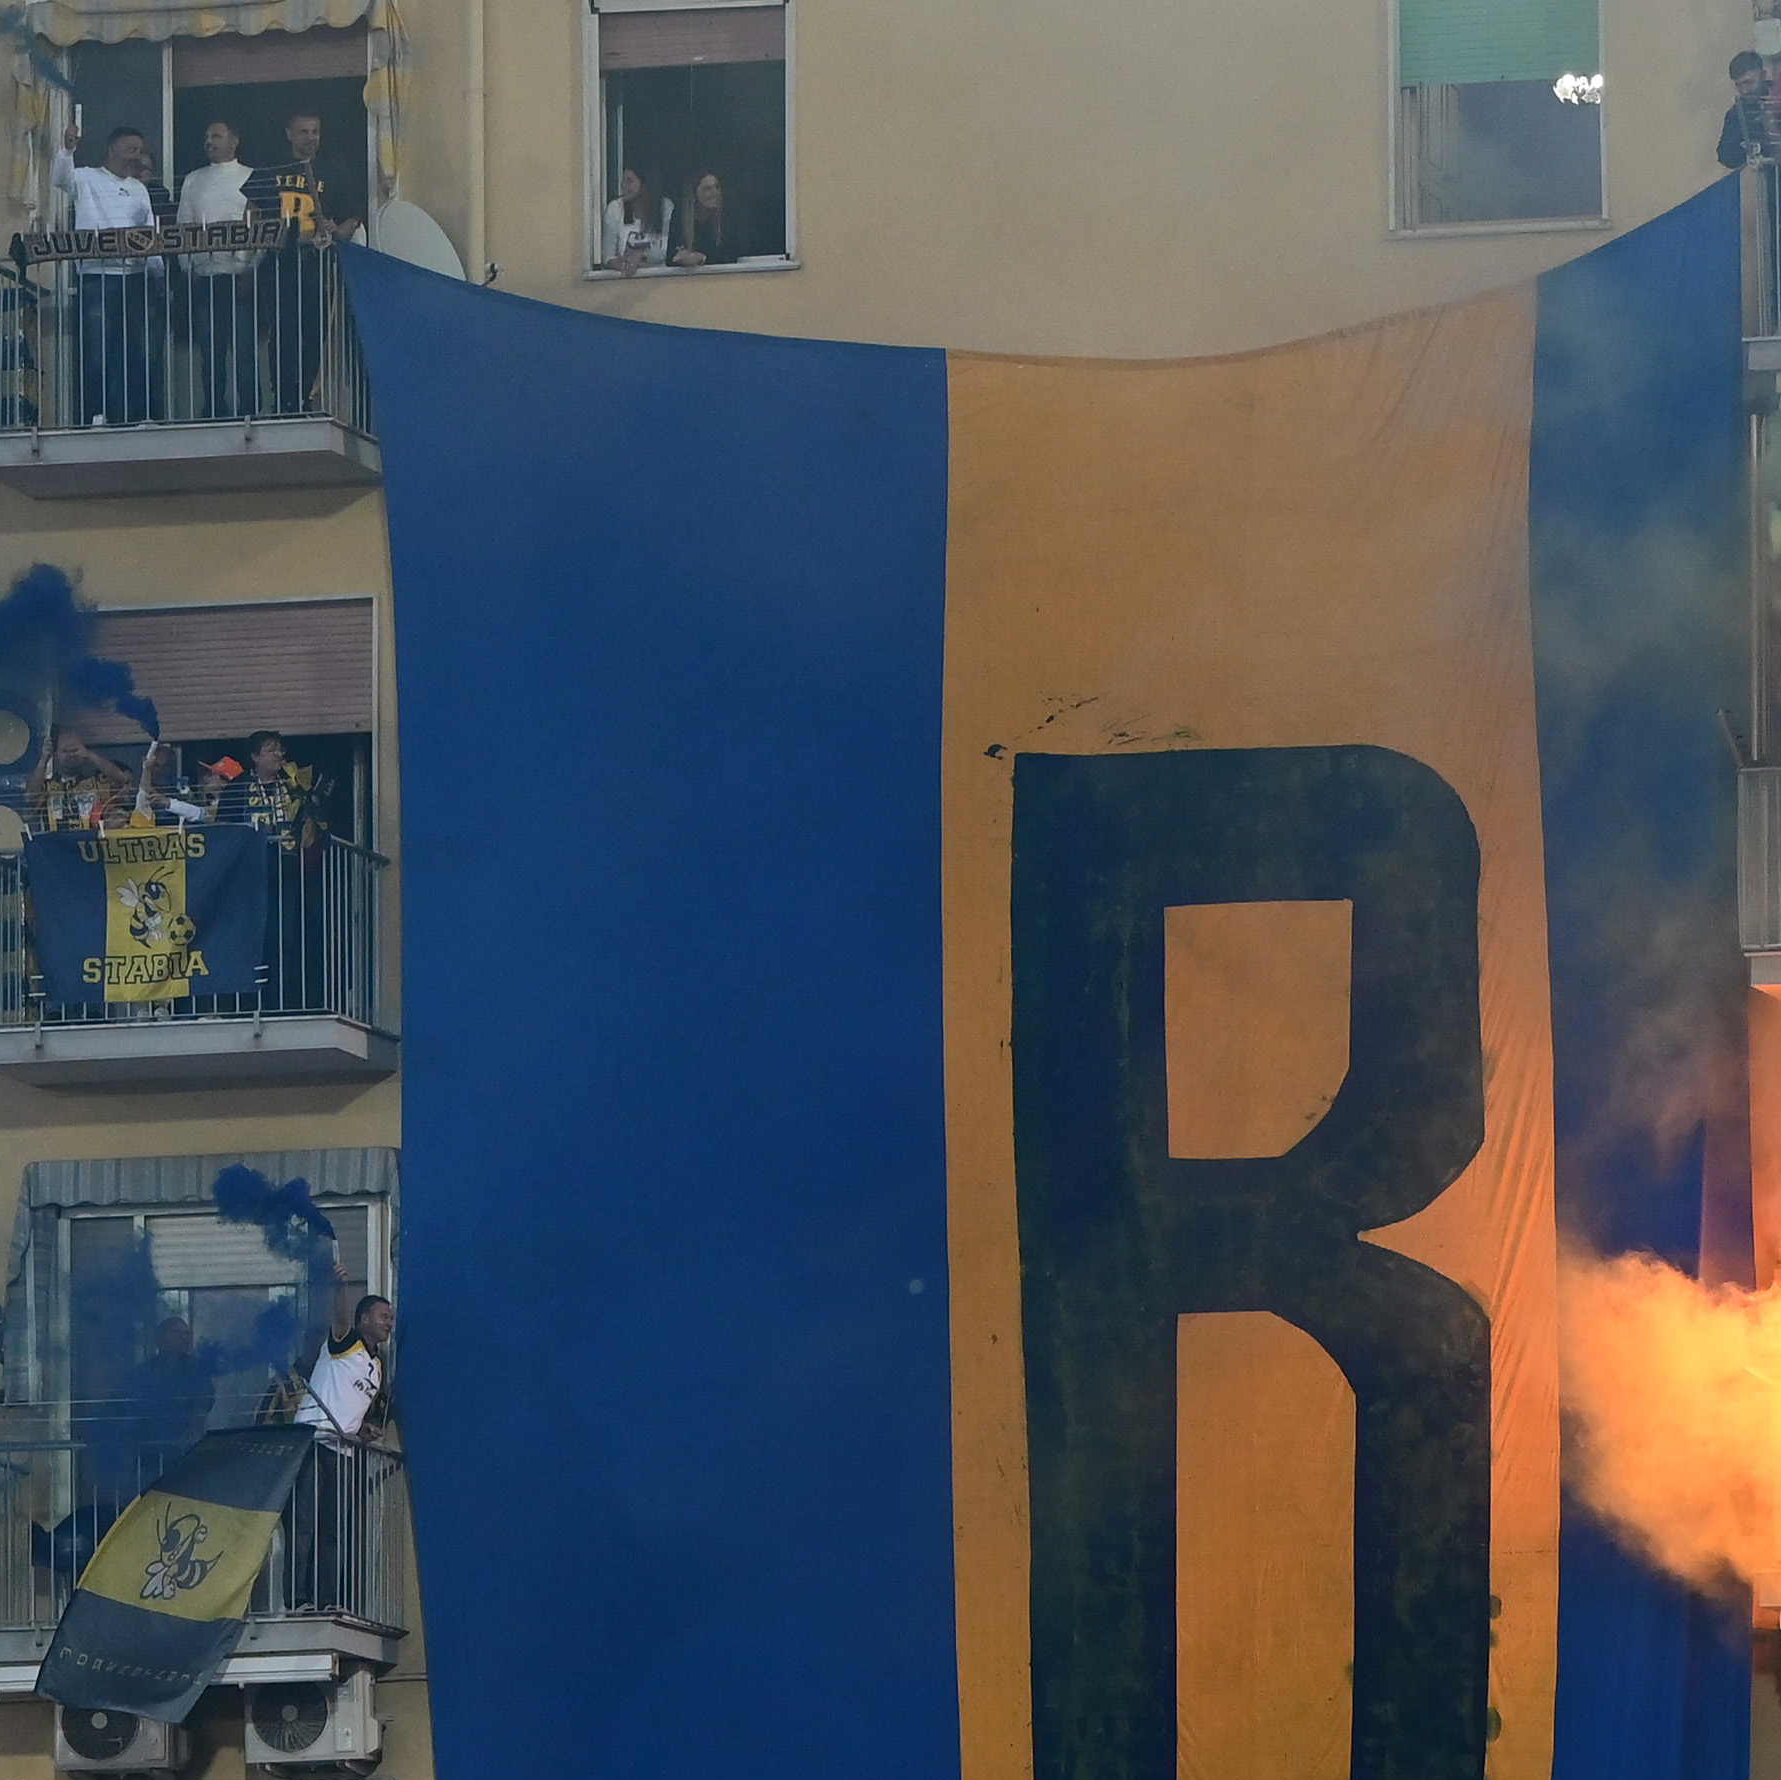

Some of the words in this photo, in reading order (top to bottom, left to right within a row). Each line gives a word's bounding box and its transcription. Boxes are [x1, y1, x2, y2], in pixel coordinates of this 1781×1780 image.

[275, 174, 325, 194] SERE
[32, 231, 118, 257] JUVE
[161, 221, 285, 249] STABIA
[77, 832, 207, 863] ULTRAS
[81, 949, 210, 986] STABIA
